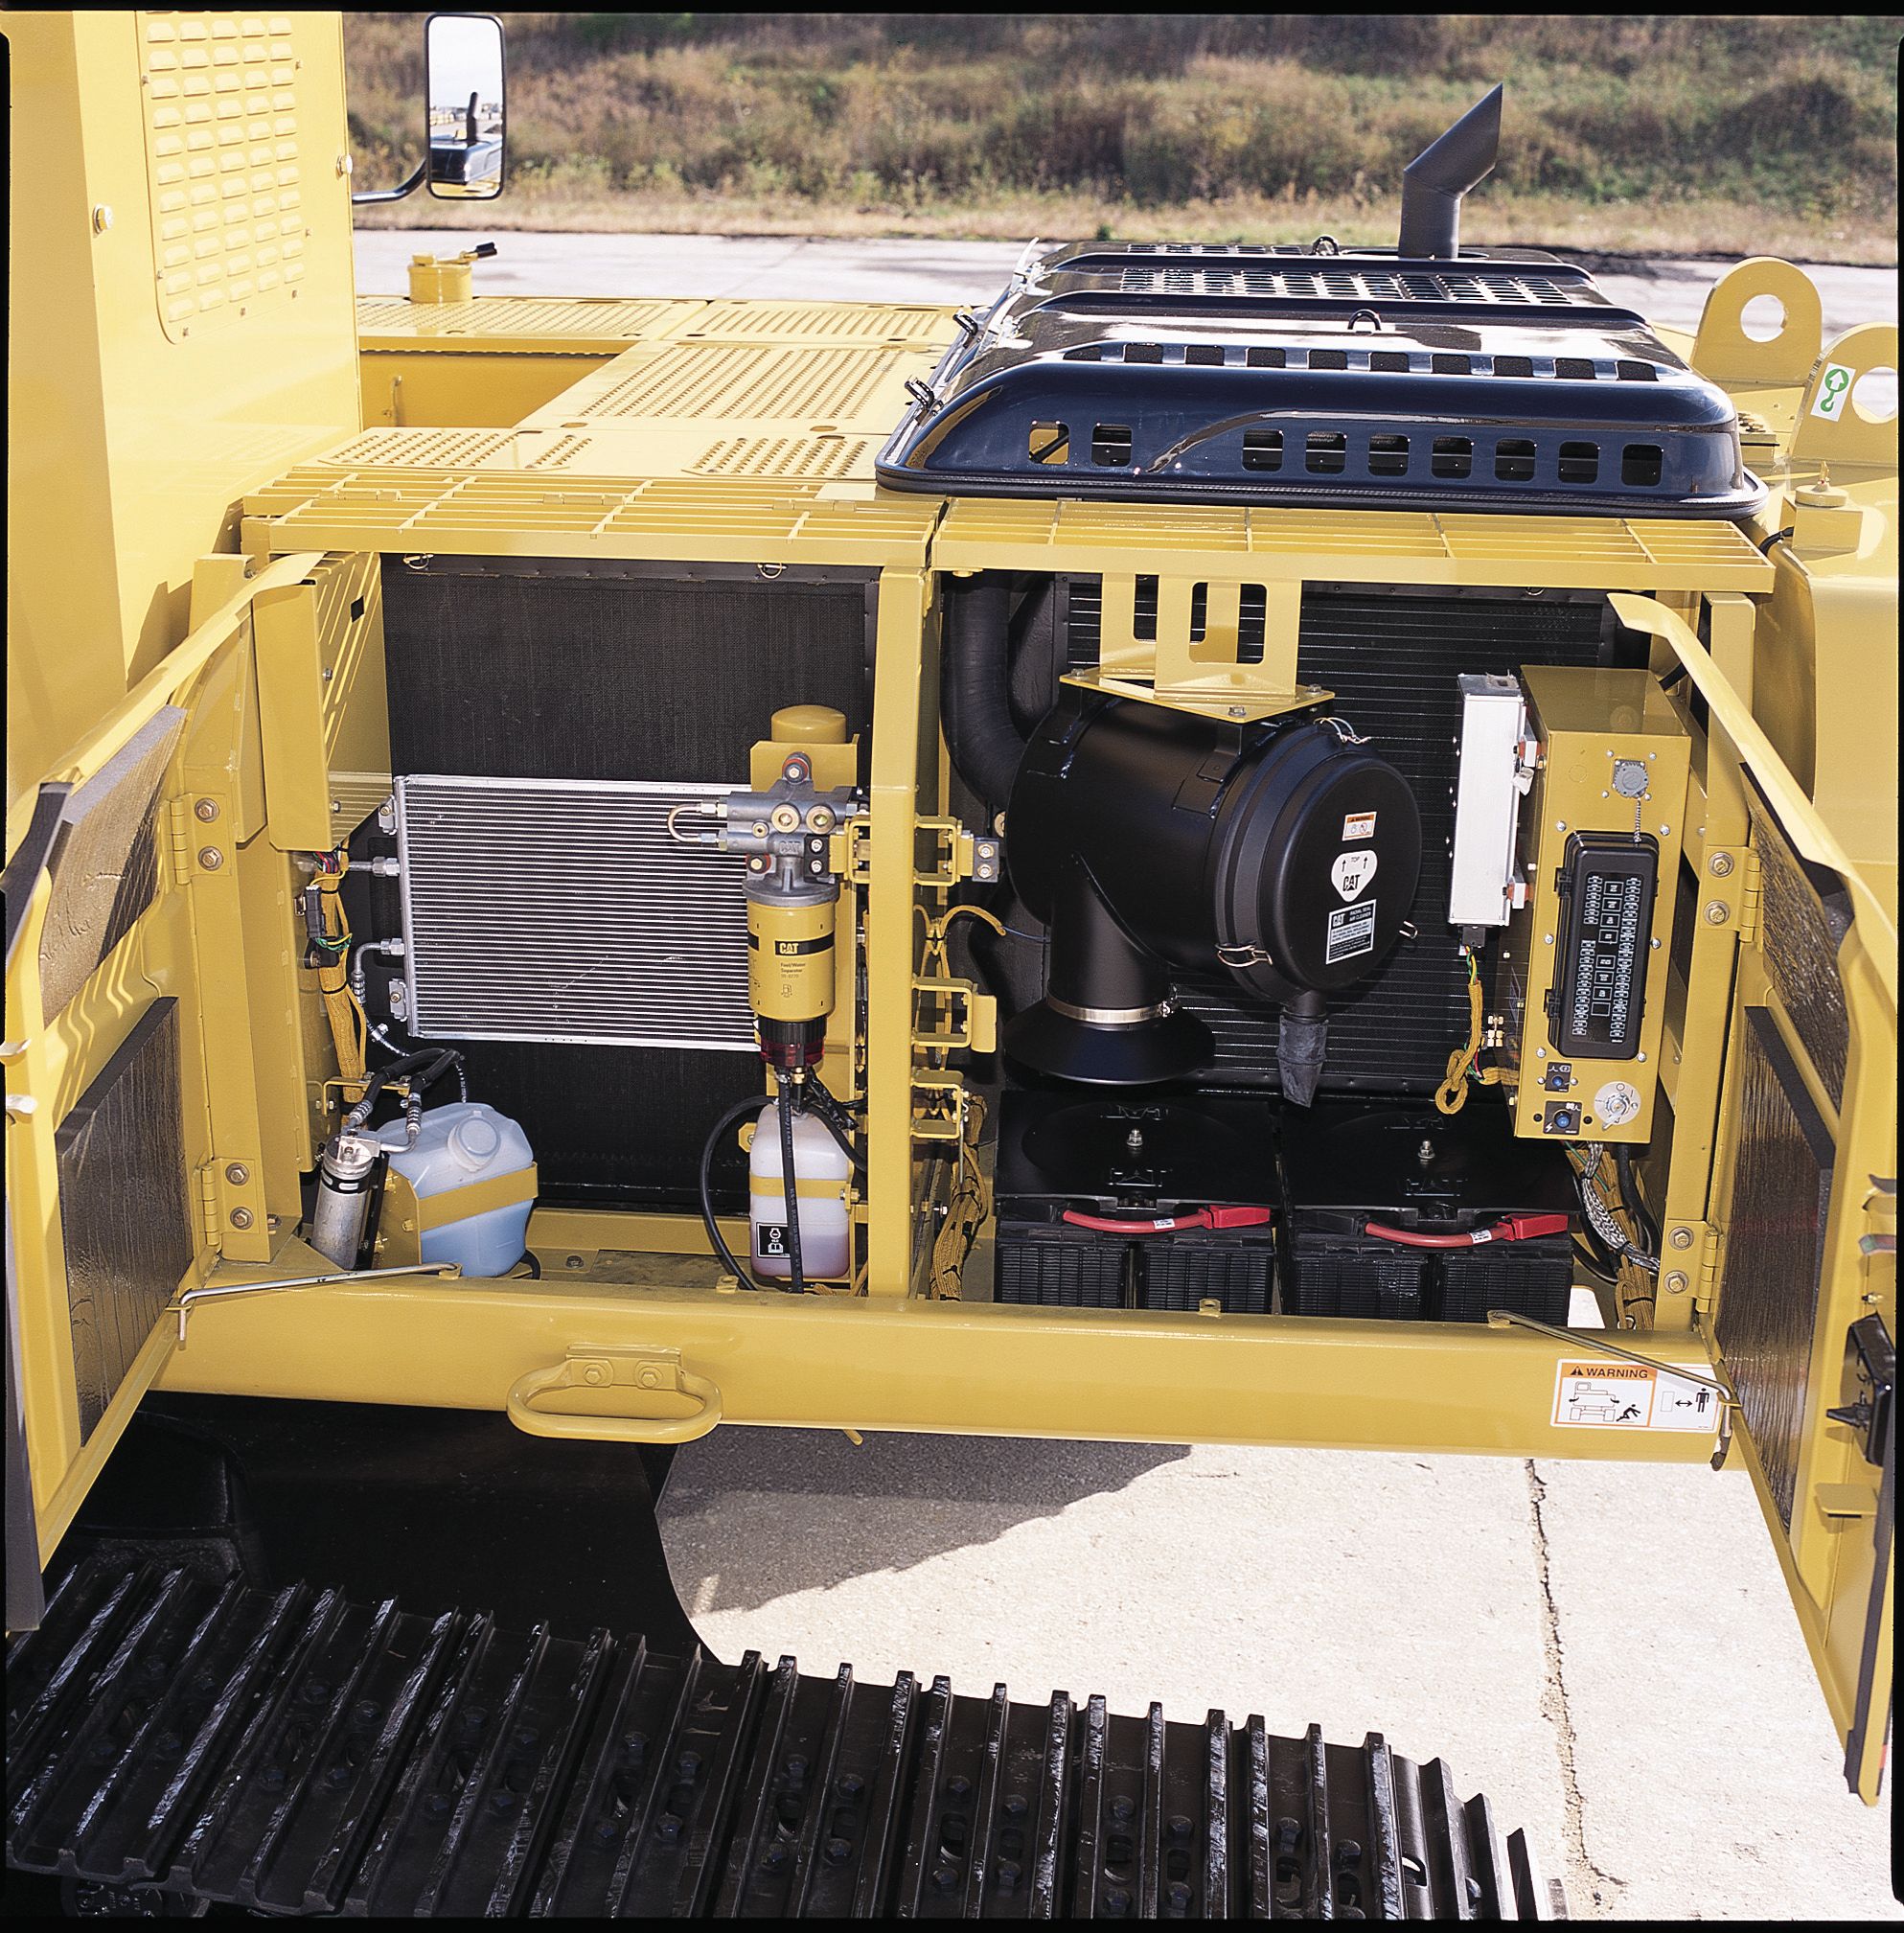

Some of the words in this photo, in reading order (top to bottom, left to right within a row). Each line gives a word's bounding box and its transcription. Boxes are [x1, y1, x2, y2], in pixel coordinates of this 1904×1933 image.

[1342, 874, 1361, 891] CAT
[1332, 913, 1345, 928] CAT
[779, 942, 798, 955] CAT
[1586, 1368, 1648, 1379] WARNING
